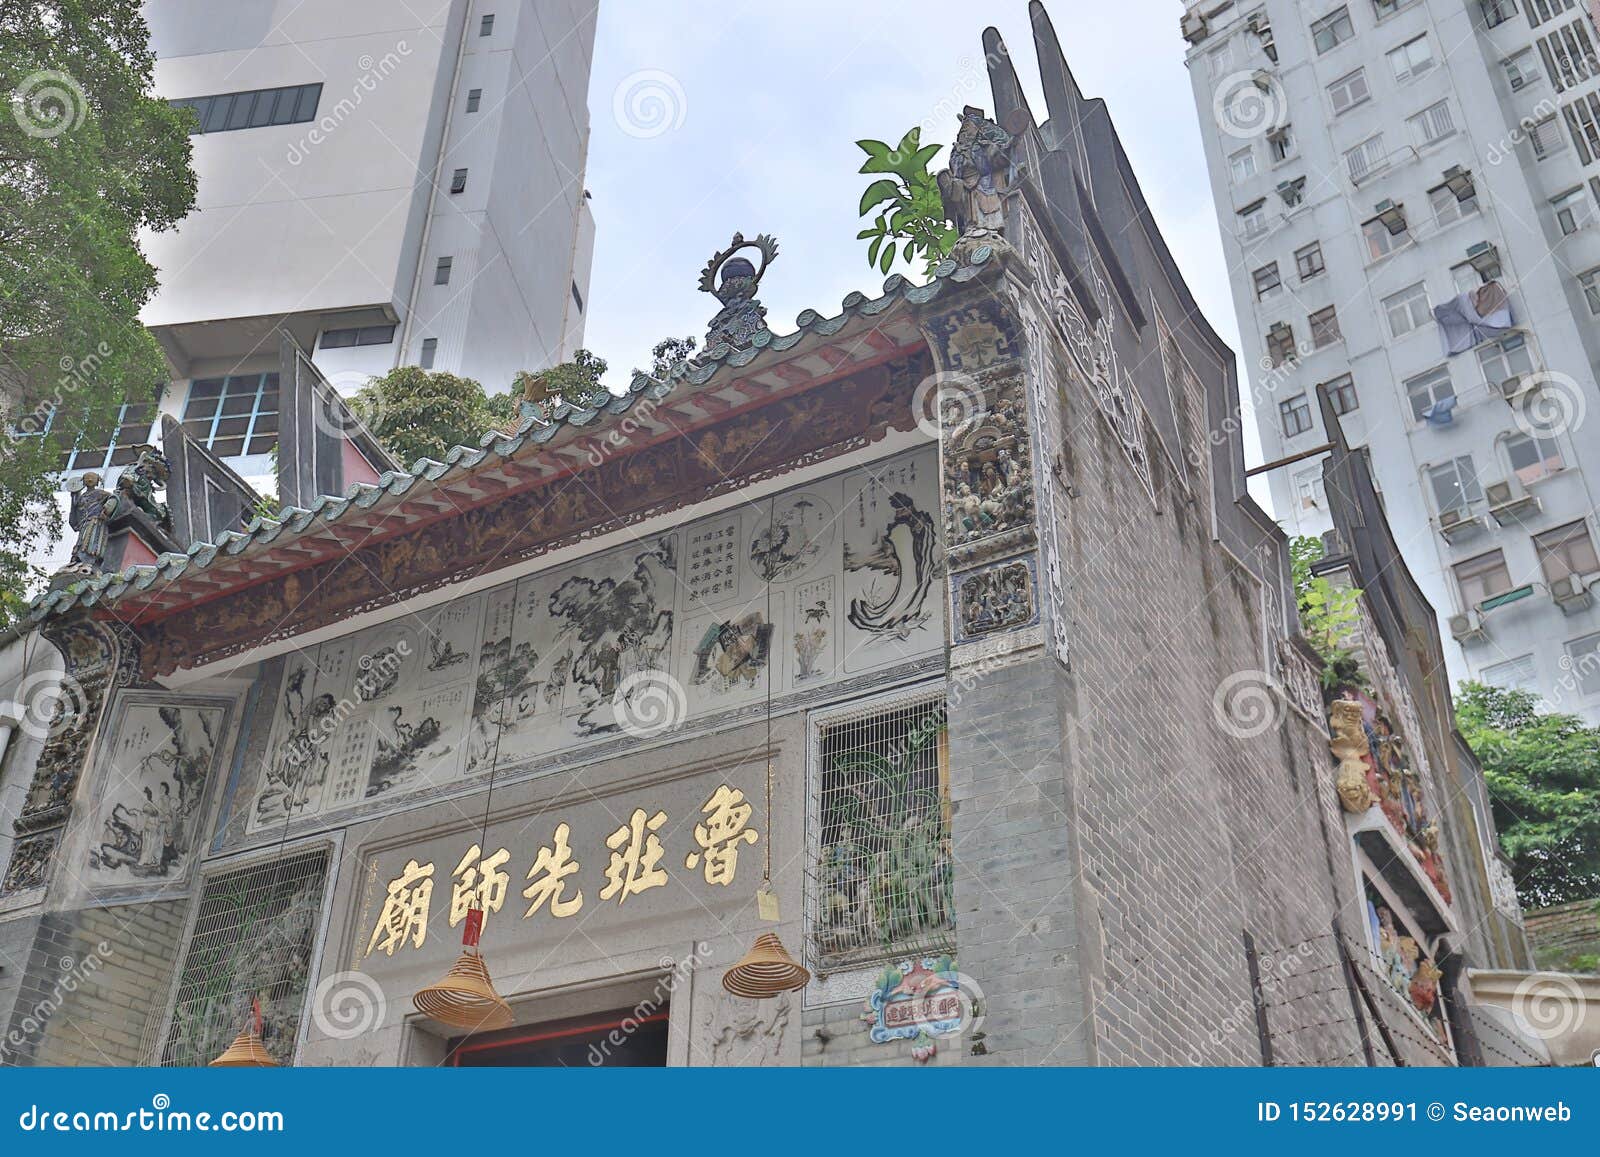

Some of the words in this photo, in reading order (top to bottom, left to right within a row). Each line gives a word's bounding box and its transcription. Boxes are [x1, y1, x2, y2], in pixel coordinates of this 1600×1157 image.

[364, 784, 759, 959] 魯班先師廟
